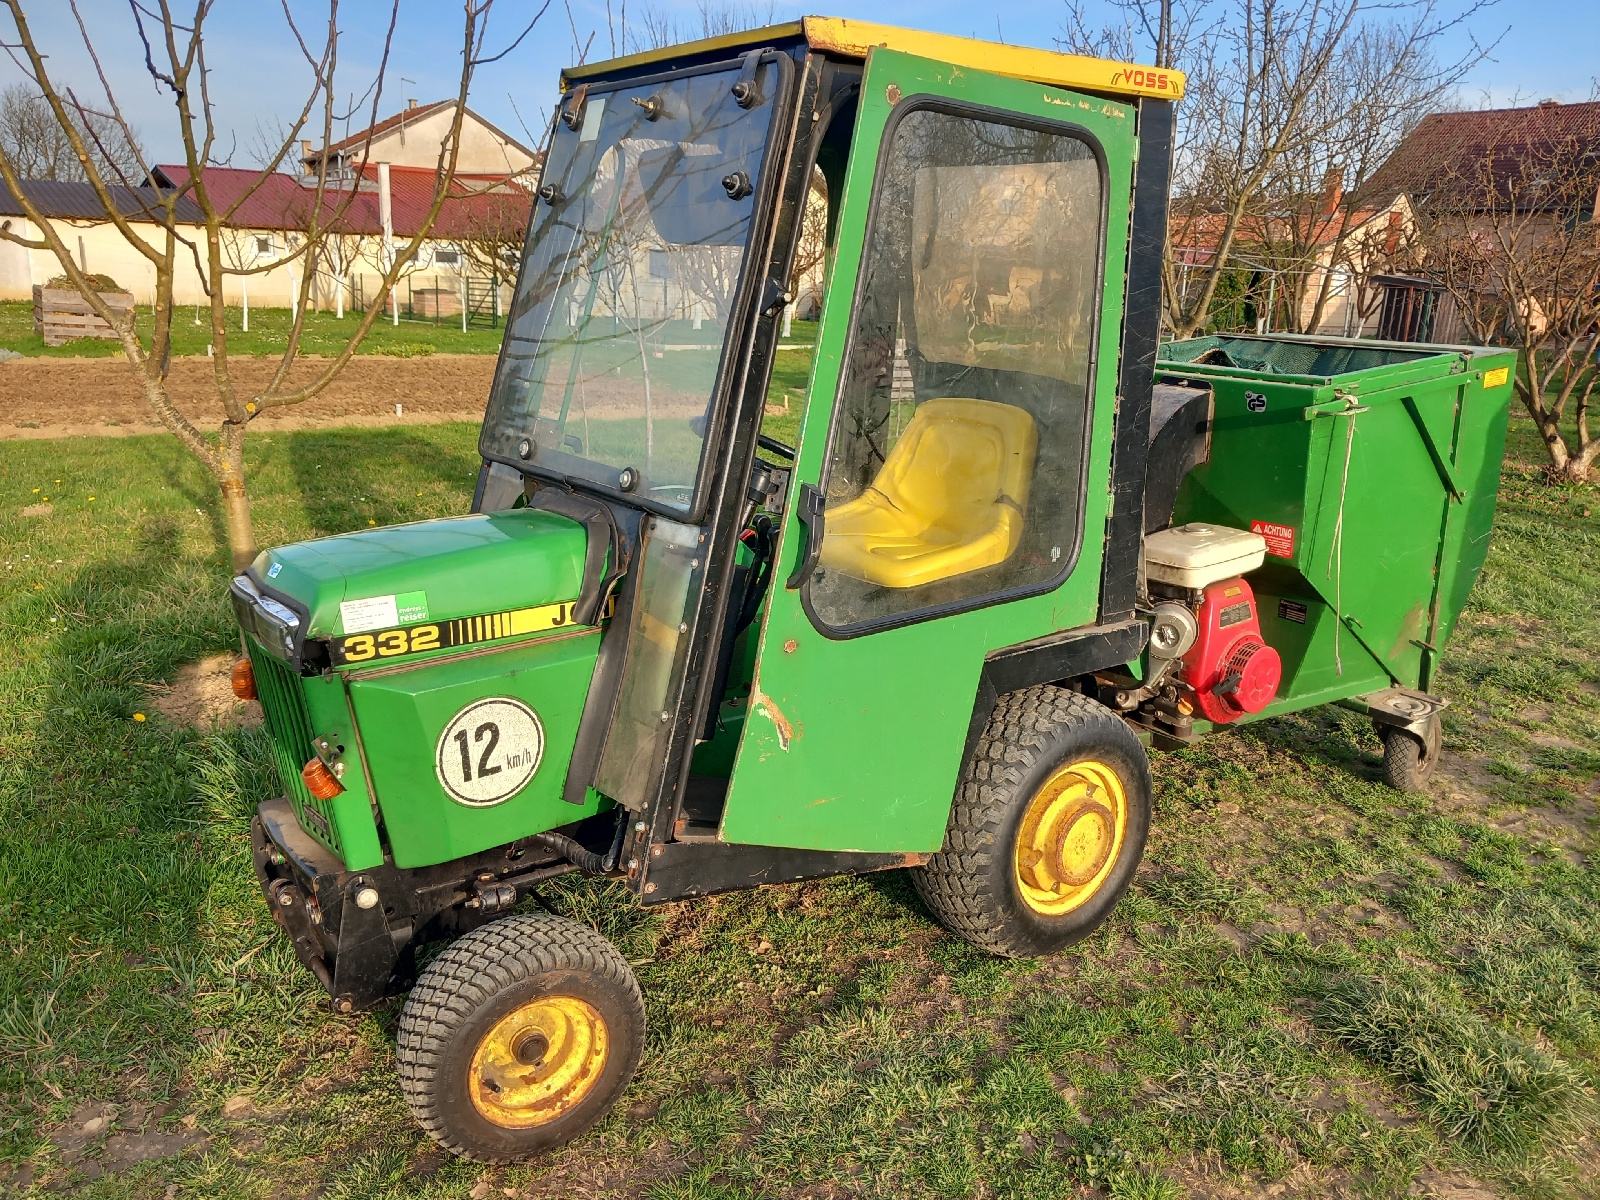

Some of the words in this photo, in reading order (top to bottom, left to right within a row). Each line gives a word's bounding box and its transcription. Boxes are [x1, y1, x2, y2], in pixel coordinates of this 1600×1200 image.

[1123, 68, 1168, 90] VOSS
[1263, 524, 1292, 539] ACHTUNG
[400, 611, 427, 623] reiser
[344, 625, 440, 661] 332
[453, 721, 502, 782] 12
[506, 746, 532, 771] km/h
